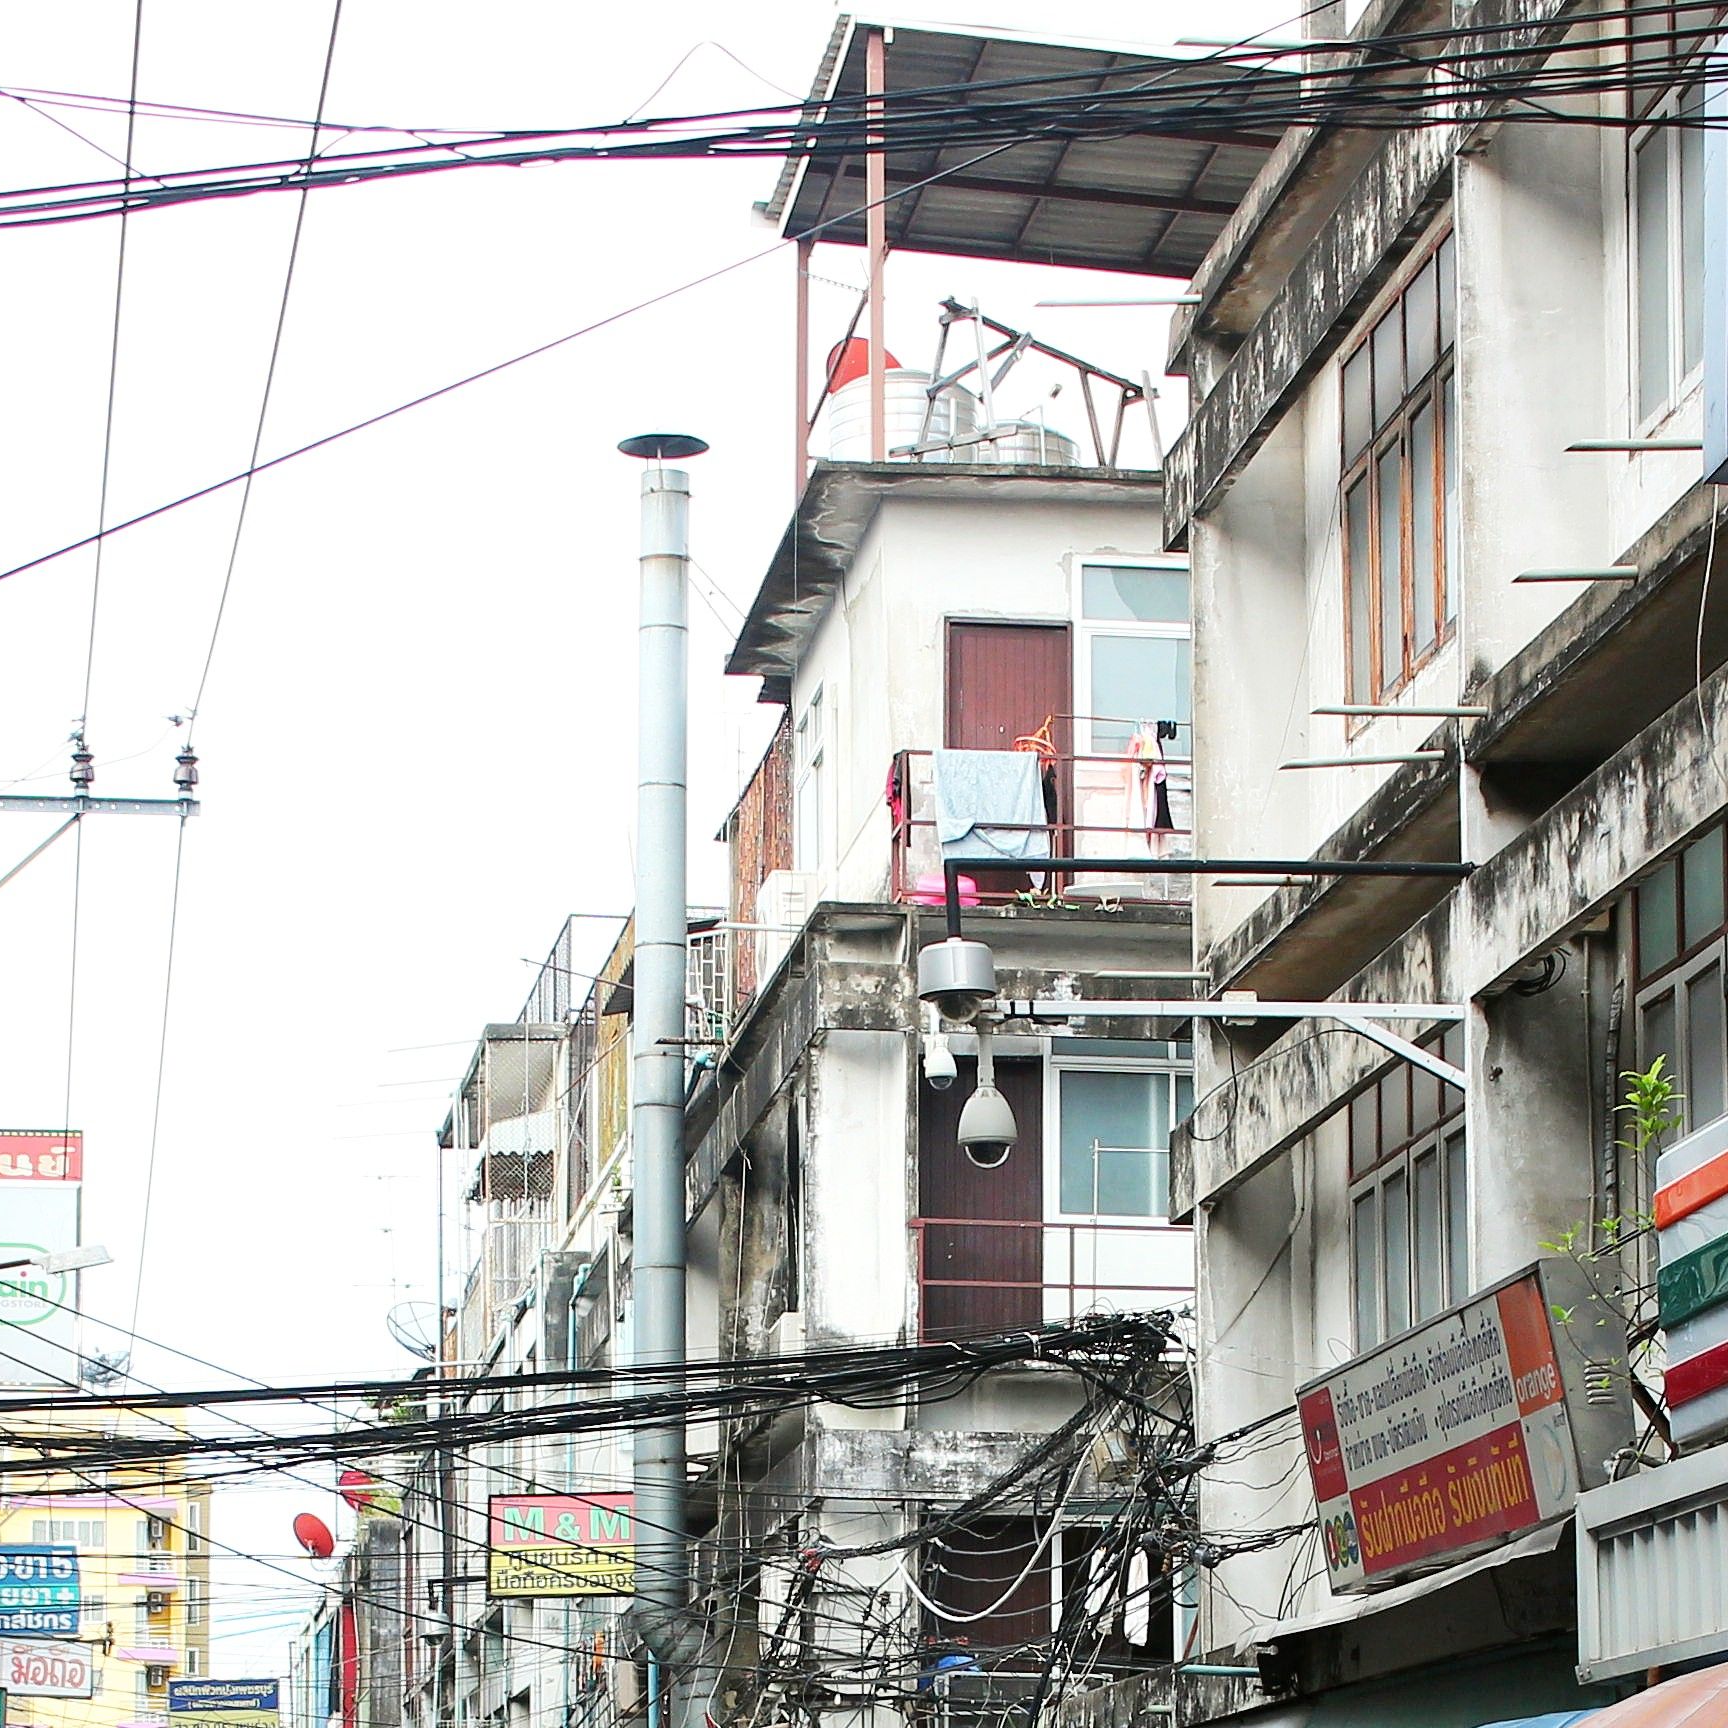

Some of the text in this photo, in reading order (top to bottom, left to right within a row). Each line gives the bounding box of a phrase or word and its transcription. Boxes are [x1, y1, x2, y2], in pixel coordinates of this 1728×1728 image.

[1517, 1362, 1556, 1403] orange
[504, 1505, 631, 1542] M & M
[11, 1645, 86, 1688] มือถือ
